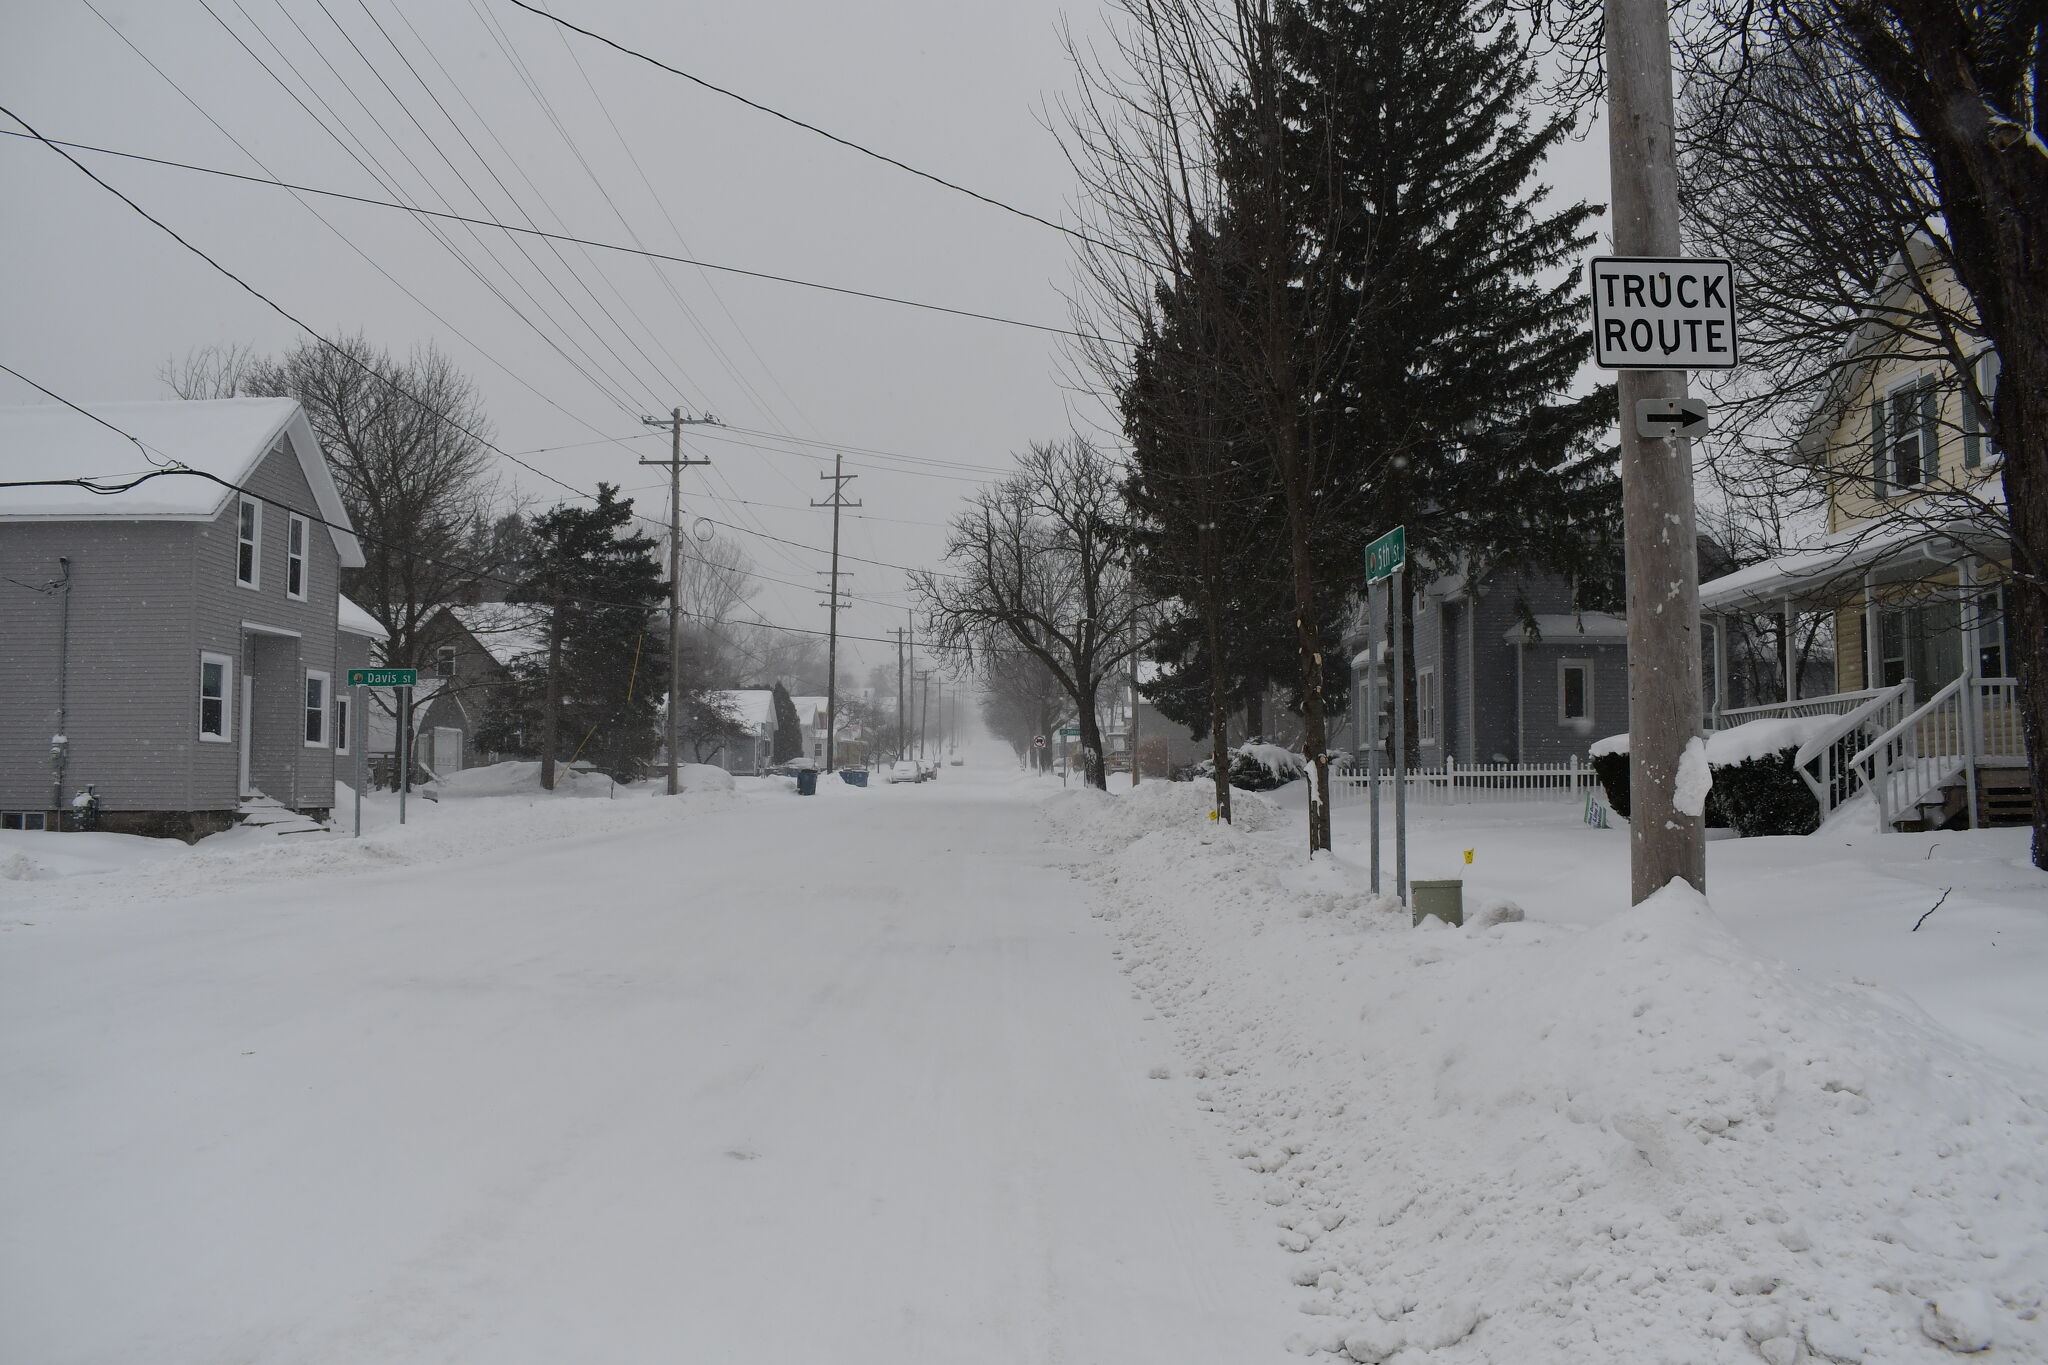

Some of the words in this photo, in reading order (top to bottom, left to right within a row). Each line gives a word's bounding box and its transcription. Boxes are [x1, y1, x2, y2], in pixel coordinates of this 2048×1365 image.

[1600, 274, 1727, 309] TRUCK
[1604, 318, 1728, 353] ROUTE
[1378, 542, 1390, 570] 5th
[1393, 543, 1400, 563] St
[368, 672, 397, 683] Davis
[403, 674, 411, 683] St
